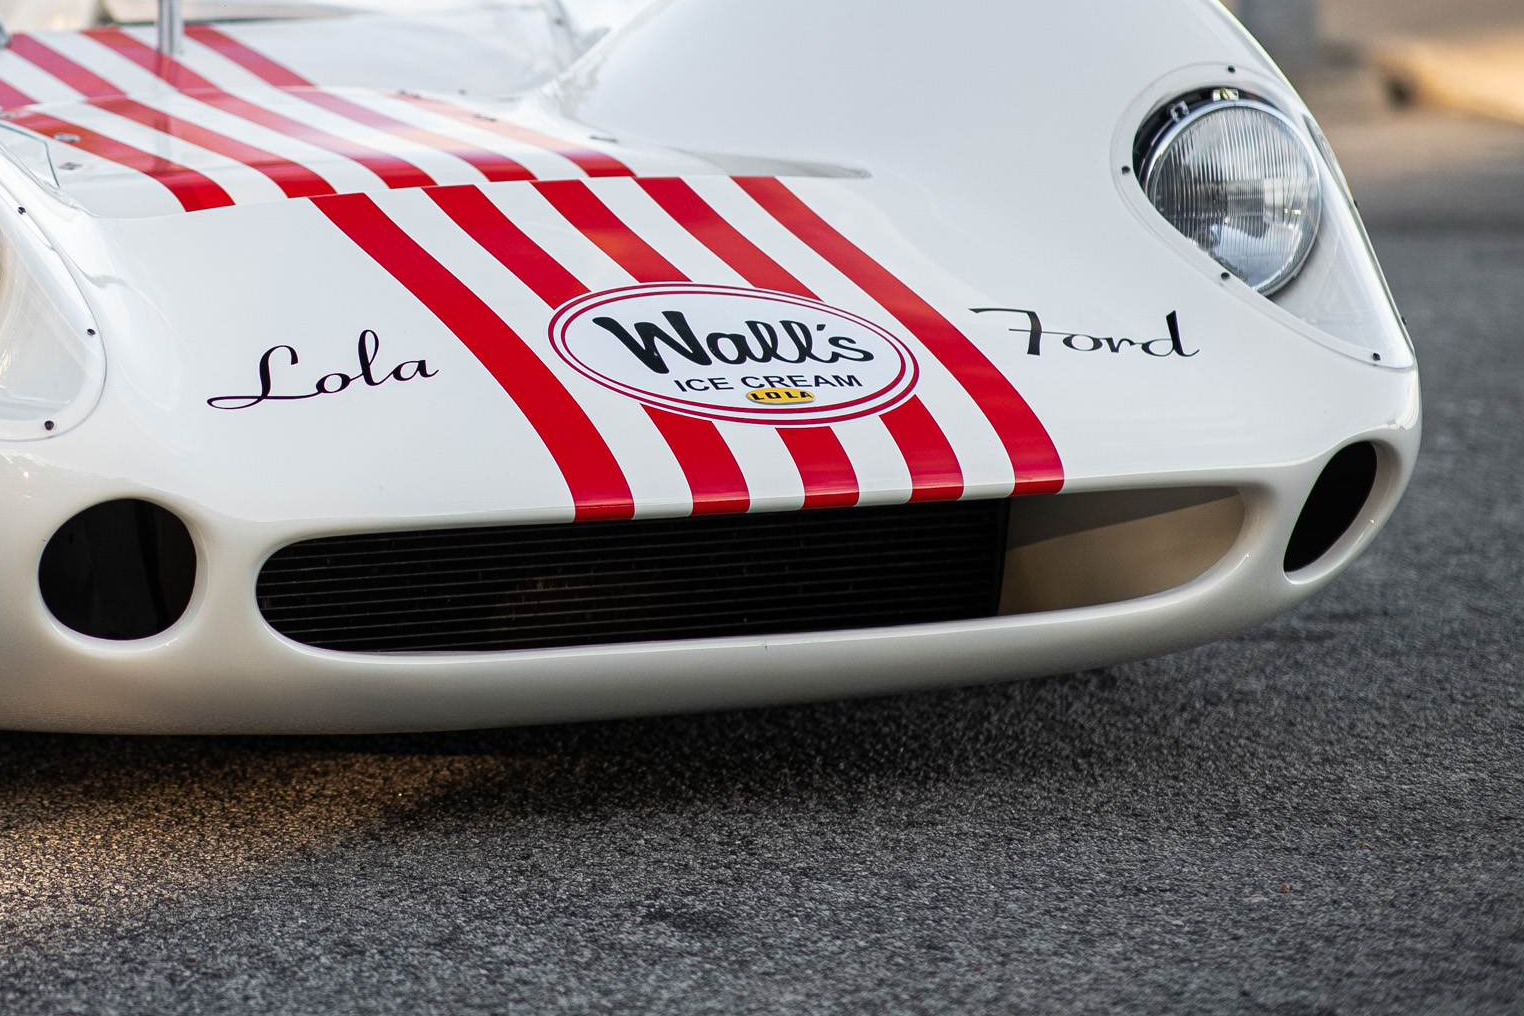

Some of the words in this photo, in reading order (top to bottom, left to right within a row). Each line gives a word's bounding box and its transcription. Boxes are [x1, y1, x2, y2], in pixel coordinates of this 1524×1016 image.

[591, 309, 875, 375] Wall's
[967, 307, 1201, 358] Ford
[206, 329, 440, 410] Lola
[673, 376, 734, 393] ICE
[740, 373, 864, 390] CREAM
[750, 390, 813, 401] LOLA
